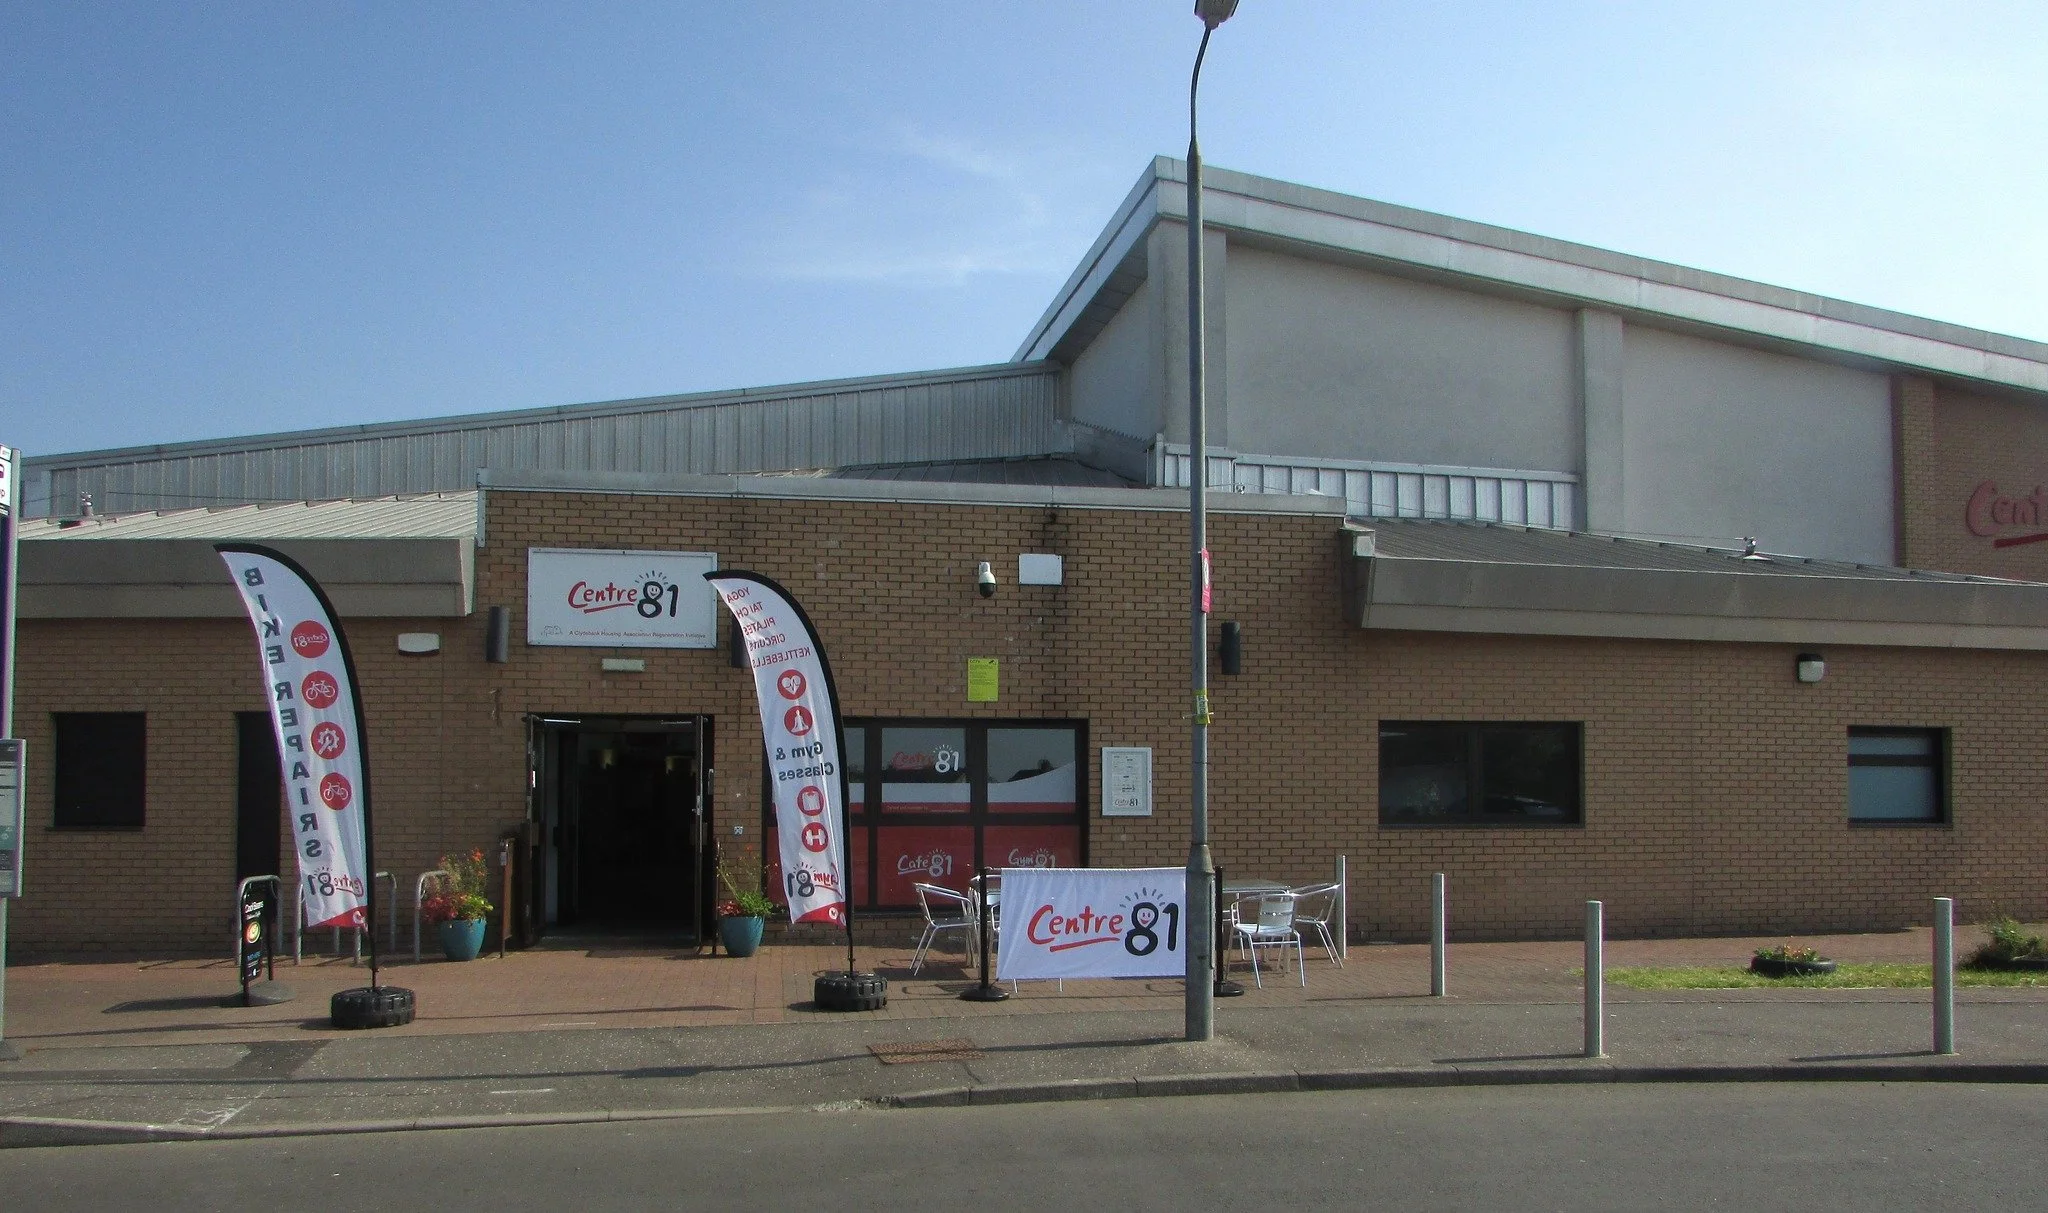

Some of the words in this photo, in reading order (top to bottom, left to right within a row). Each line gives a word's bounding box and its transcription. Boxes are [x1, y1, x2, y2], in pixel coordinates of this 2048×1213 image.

[568, 580, 638, 613] Centre
[637, 580, 679, 618] 81
[935, 750, 959, 773] 81
[928, 854, 952, 877] 81
[1008, 849, 1034, 867] Gym
[1027, 904, 1124, 950] Centre
[1125, 902, 1179, 956] 81
